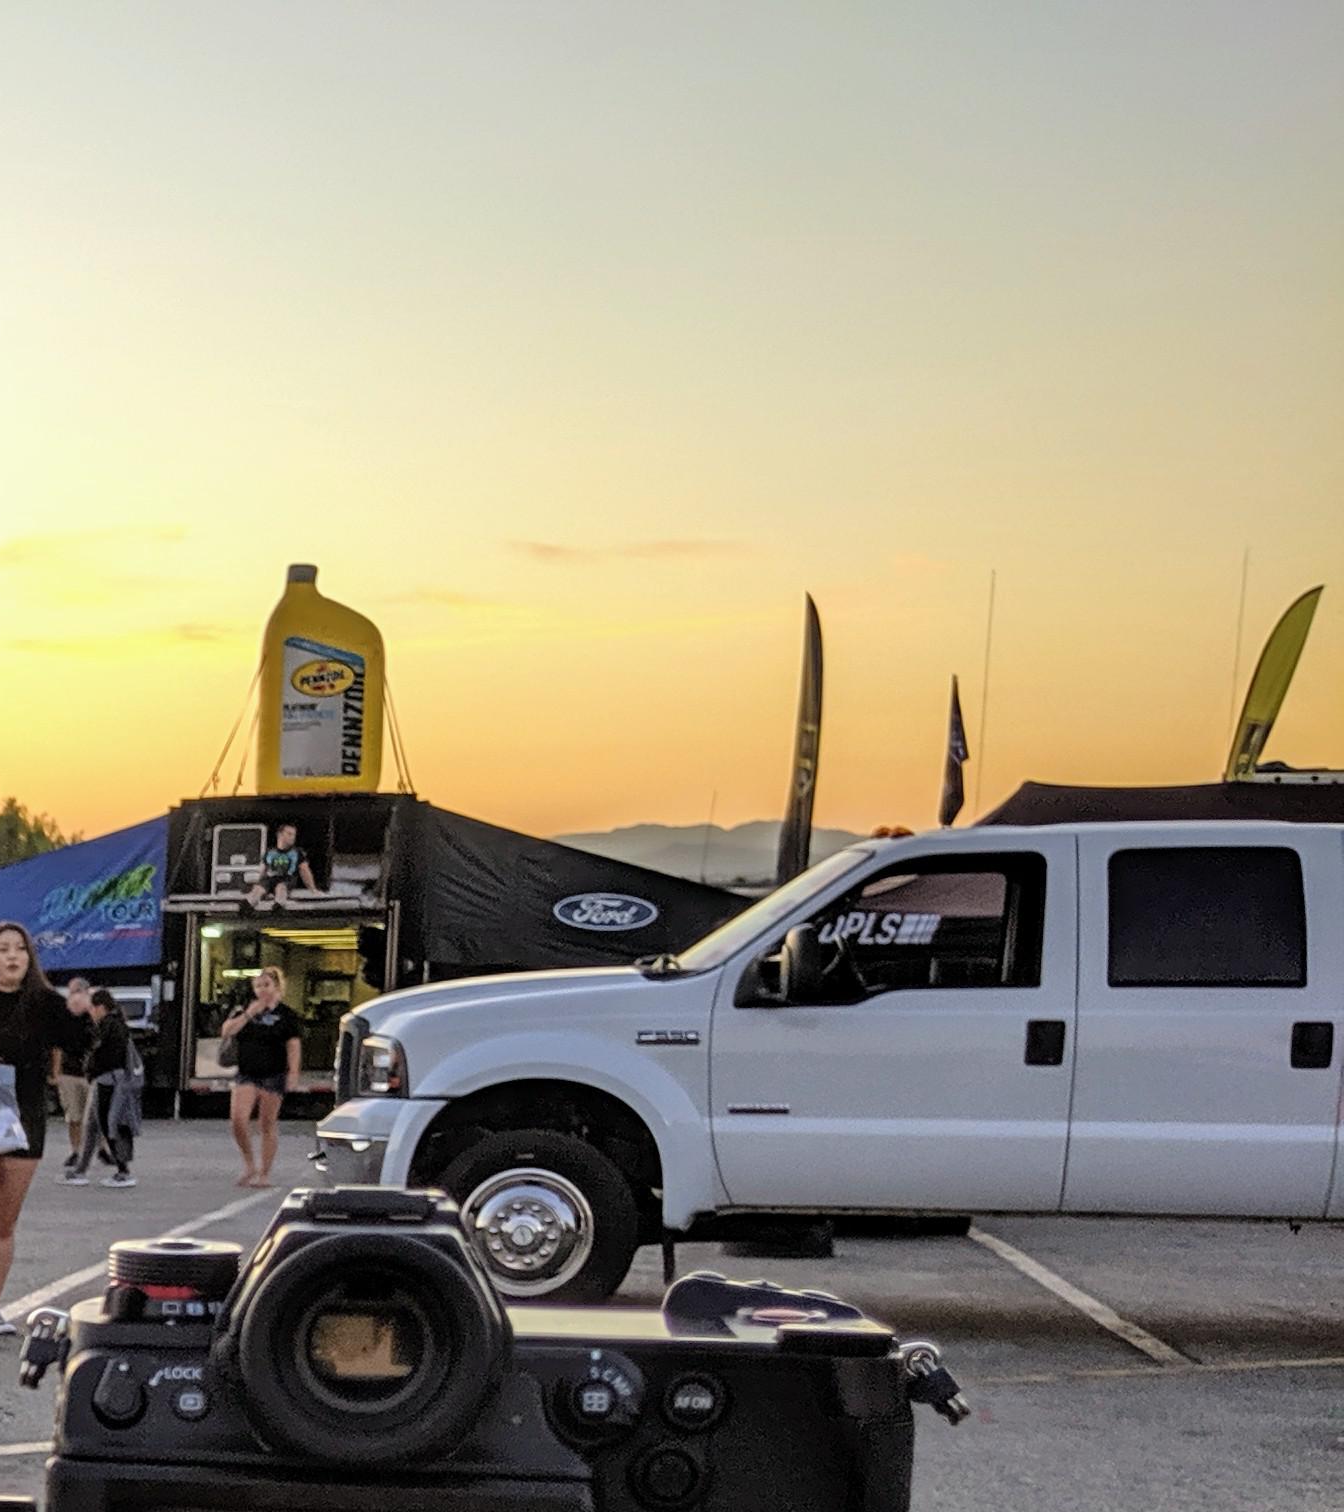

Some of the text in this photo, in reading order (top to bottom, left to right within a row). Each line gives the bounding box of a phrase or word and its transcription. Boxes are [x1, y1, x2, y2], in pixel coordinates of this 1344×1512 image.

[102, 900, 156, 922] TOUR
[572, 897, 639, 924] Ford
[163, 1366, 202, 1380] LOCK
